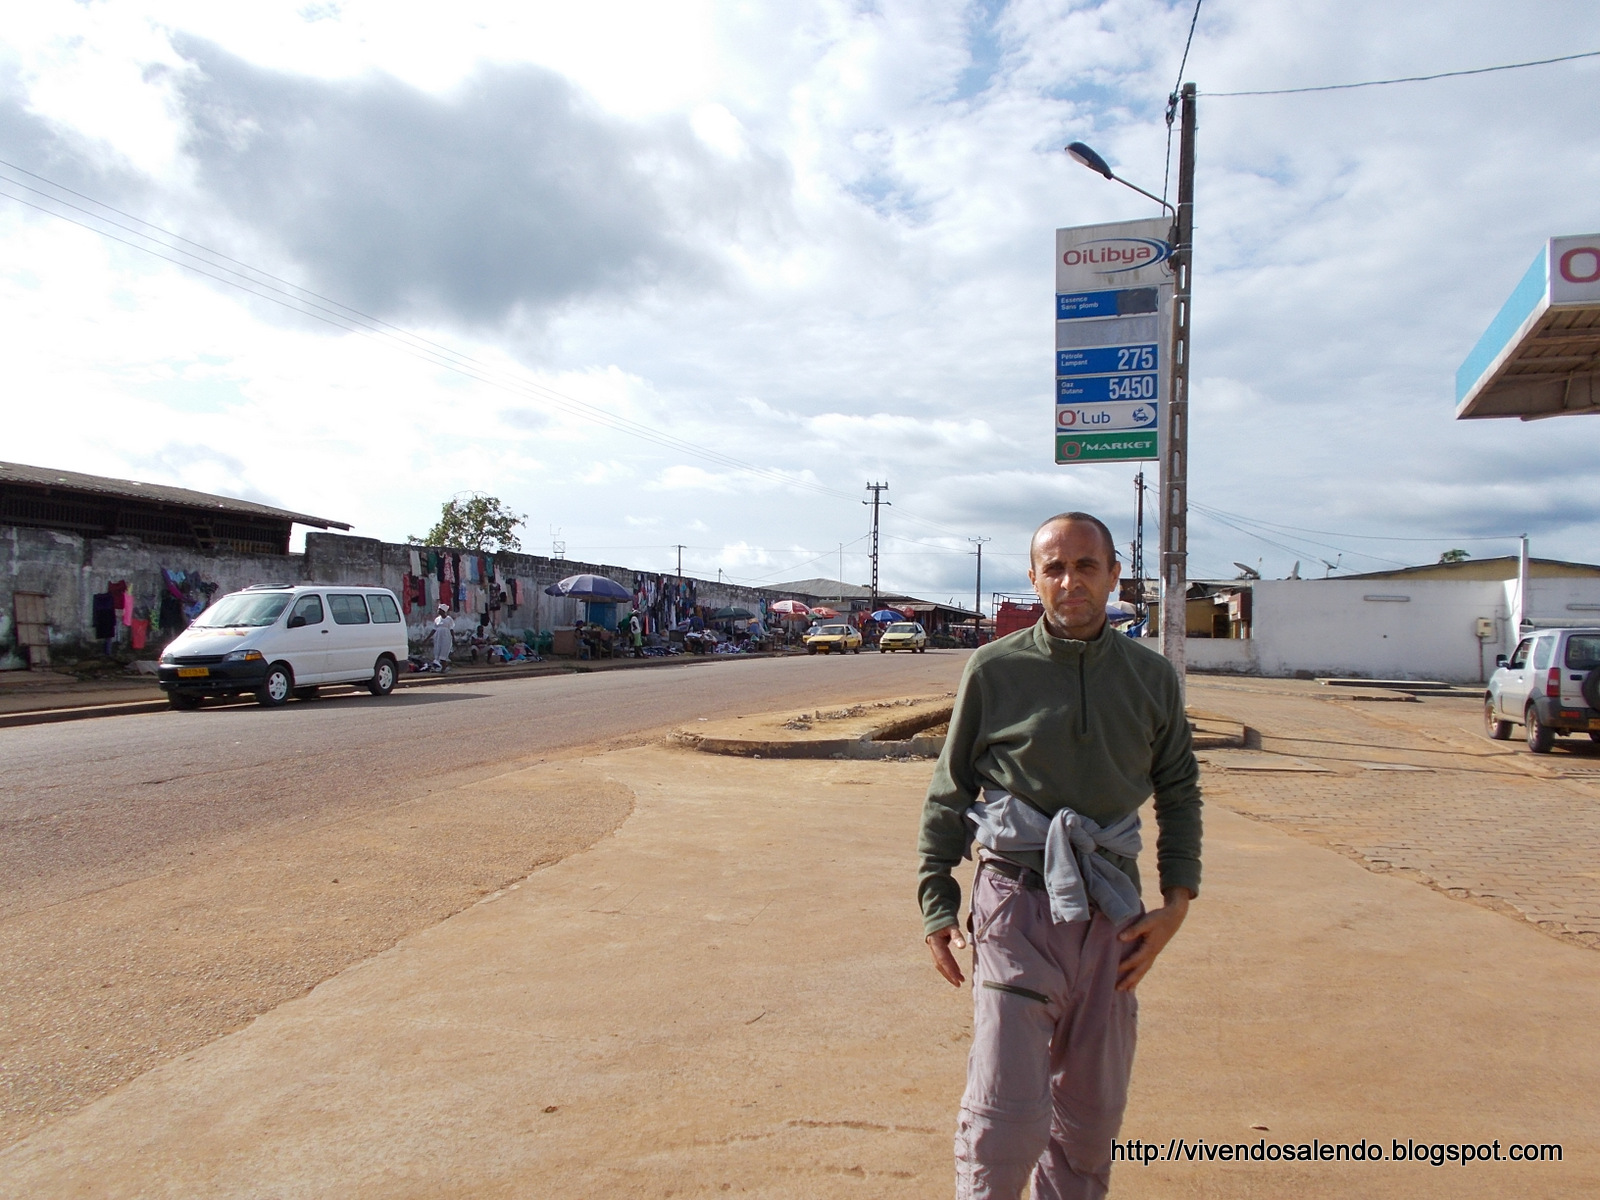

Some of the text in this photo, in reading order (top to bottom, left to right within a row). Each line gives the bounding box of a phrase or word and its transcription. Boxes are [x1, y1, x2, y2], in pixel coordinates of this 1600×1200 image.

[1060, 296, 1088, 304] Essence
[1079, 302, 1099, 310] plomb
[1117, 347, 1154, 370] 275
[1061, 359, 1088, 367] Lampant
[1061, 387, 1083, 395] Butane
[1108, 376, 1154, 400] 5450
[1058, 409, 1111, 426] O'Lub
